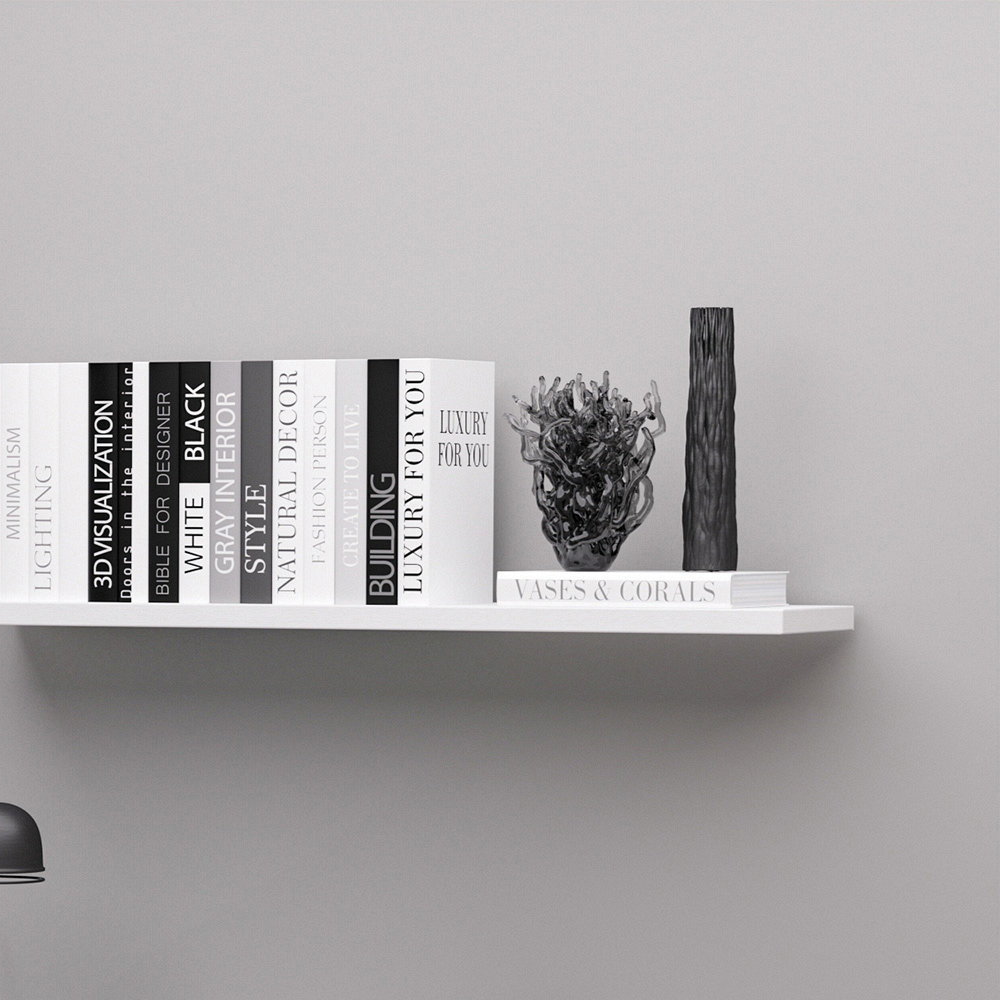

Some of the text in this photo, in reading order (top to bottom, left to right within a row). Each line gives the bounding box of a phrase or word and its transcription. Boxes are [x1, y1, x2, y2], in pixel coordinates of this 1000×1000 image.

[6, 427, 21, 540] MINIMALISM
[120, 367, 133, 599] Doors in the interior
[184, 382, 205, 461] BLACK
[214, 391, 236, 574] GRAY INTERIOR
[277, 370, 298, 594] NATURAL DECOR
[312, 395, 327, 563] FASHION PERSON
[403, 369, 425, 594] LUXURY FOR YOU
[438, 442, 490, 468] FOR YOU
[439, 409, 489, 436] LUXURY
[34, 465, 53, 591] LIGHTING
[94, 400, 114, 588] 3D VISUALIZATION
[156, 391, 171, 595] BIBLE FOR DESIGNER
[184, 497, 204, 574] WHITE
[244, 484, 267, 574] STYLE
[342, 404, 360, 568] CREATE TO LIVE
[369, 473, 396, 596] BUILDING
[515, 579, 716, 602] VASES & CORALS
